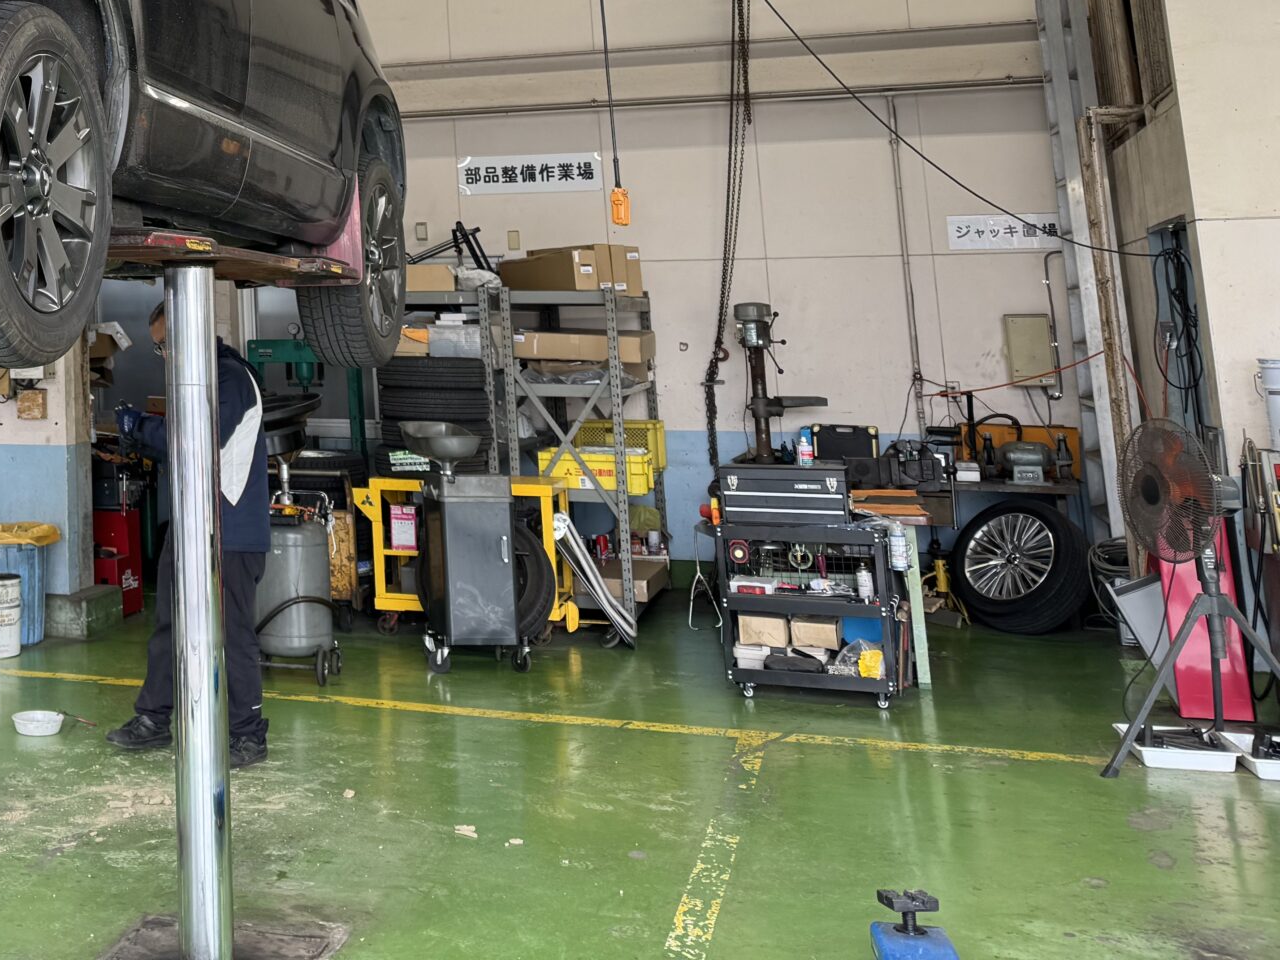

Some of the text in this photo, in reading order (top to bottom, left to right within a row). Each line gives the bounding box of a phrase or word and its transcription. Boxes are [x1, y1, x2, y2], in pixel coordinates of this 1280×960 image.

[464, 161, 595, 185] 部品整備作業場
[955, 222, 1059, 239] ジャッキ置場
